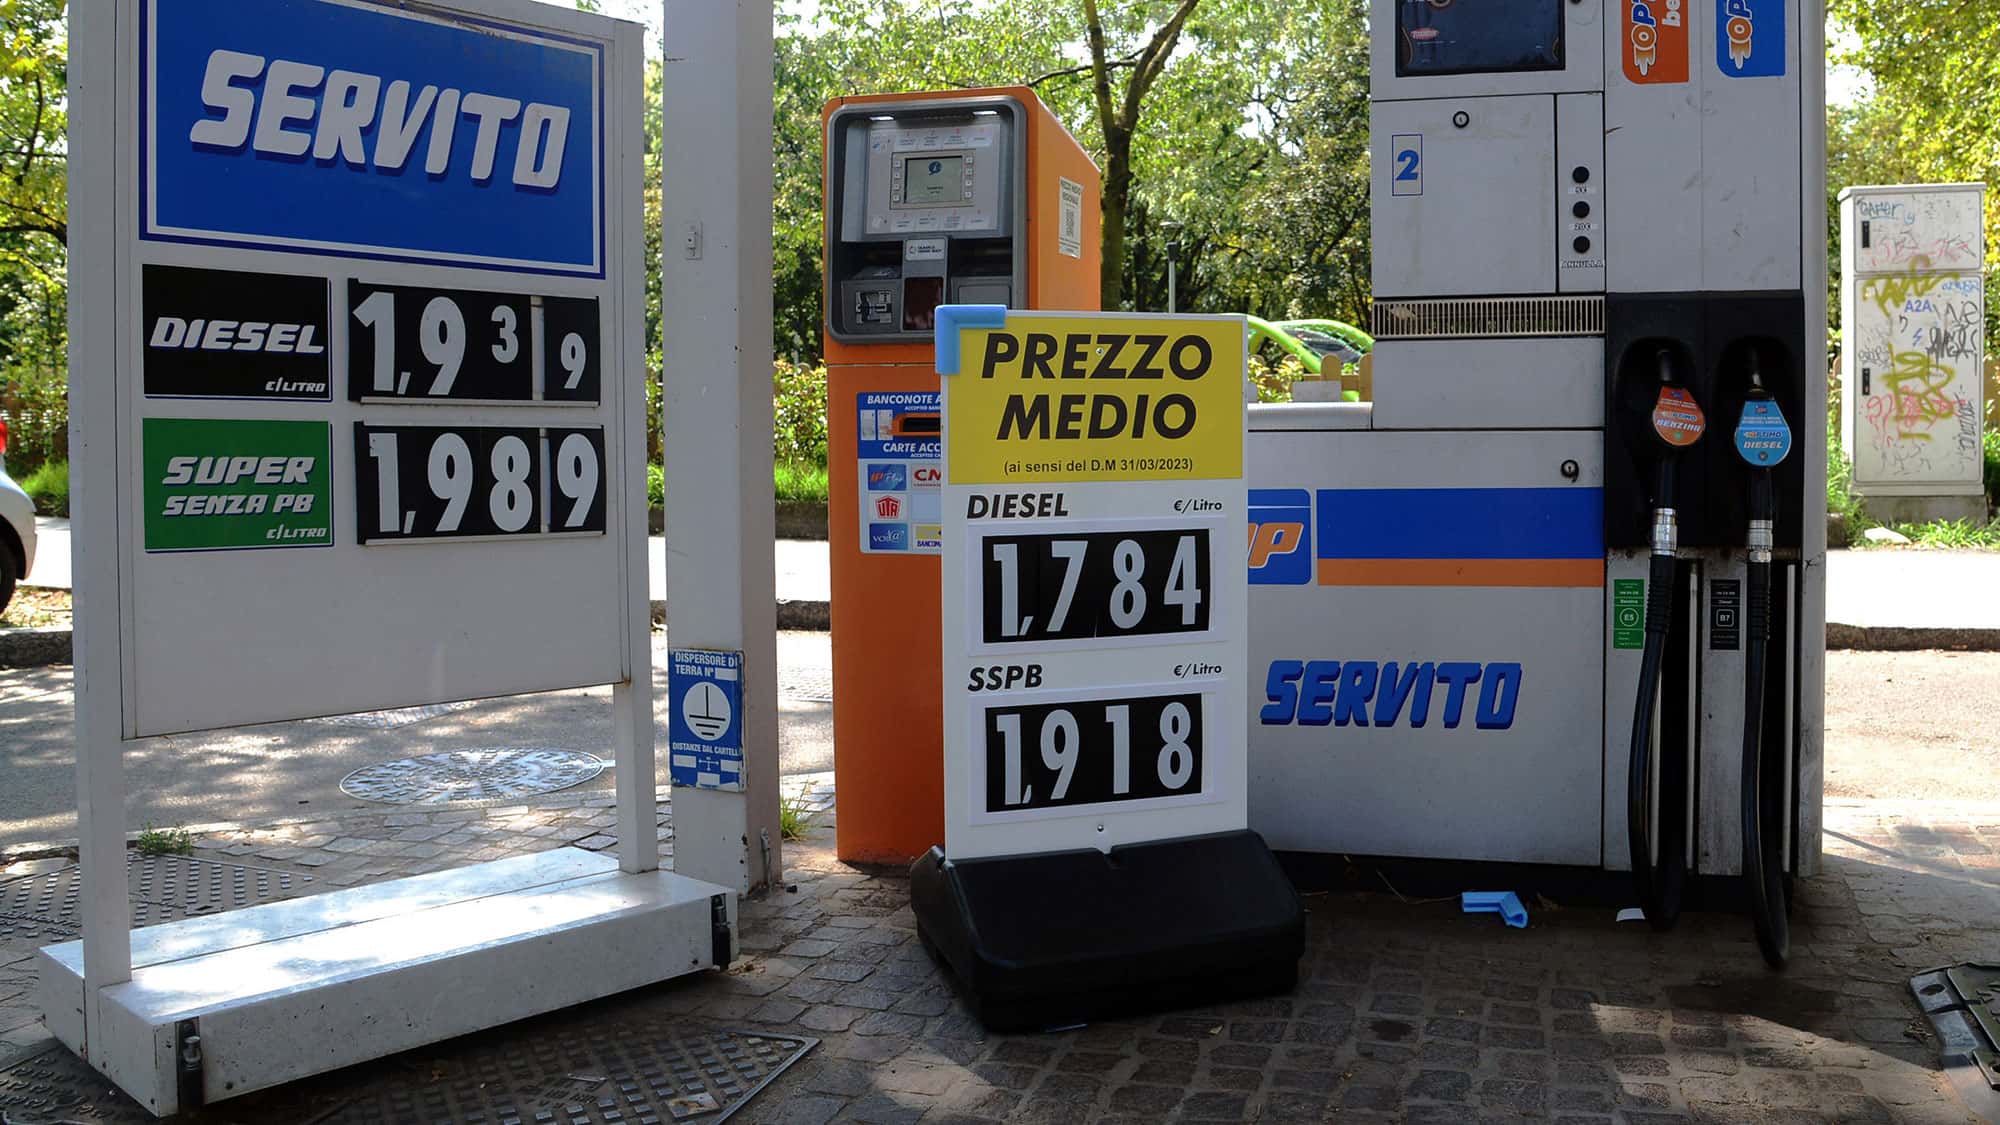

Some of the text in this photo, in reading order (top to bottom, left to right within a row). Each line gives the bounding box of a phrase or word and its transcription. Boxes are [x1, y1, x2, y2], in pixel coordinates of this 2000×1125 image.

[189, 48, 572, 191] SERVITO
[1395, 149, 1419, 181] 2
[1904, 299, 1933, 313] A2A
[150, 316, 325, 354] DIESEL
[981, 332, 1213, 381] PREZZO
[867, 394, 933, 405] BANCONOTE
[996, 393, 1197, 440] MEDIO
[882, 442, 916, 453] CARTE
[1743, 441, 1783, 449] DIESEL
[162, 456, 315, 485] SUPER
[1004, 458, 1193, 476] (ai sensi del D.M 31/03/2023)
[162, 494, 315, 515] SENZA PB
[967, 493, 1222, 519] DIESEL €/Litro
[993, 535, 1202, 637] 1,784
[674, 651, 738, 668] DISPERSORE DI
[674, 663, 704, 676] TERRA
[967, 663, 1222, 691] SSPB €/Litro
[1260, 660, 1522, 730] SERVITO
[672, 742, 701, 752] DISTANZE
[996, 702, 1193, 806] 1,918
